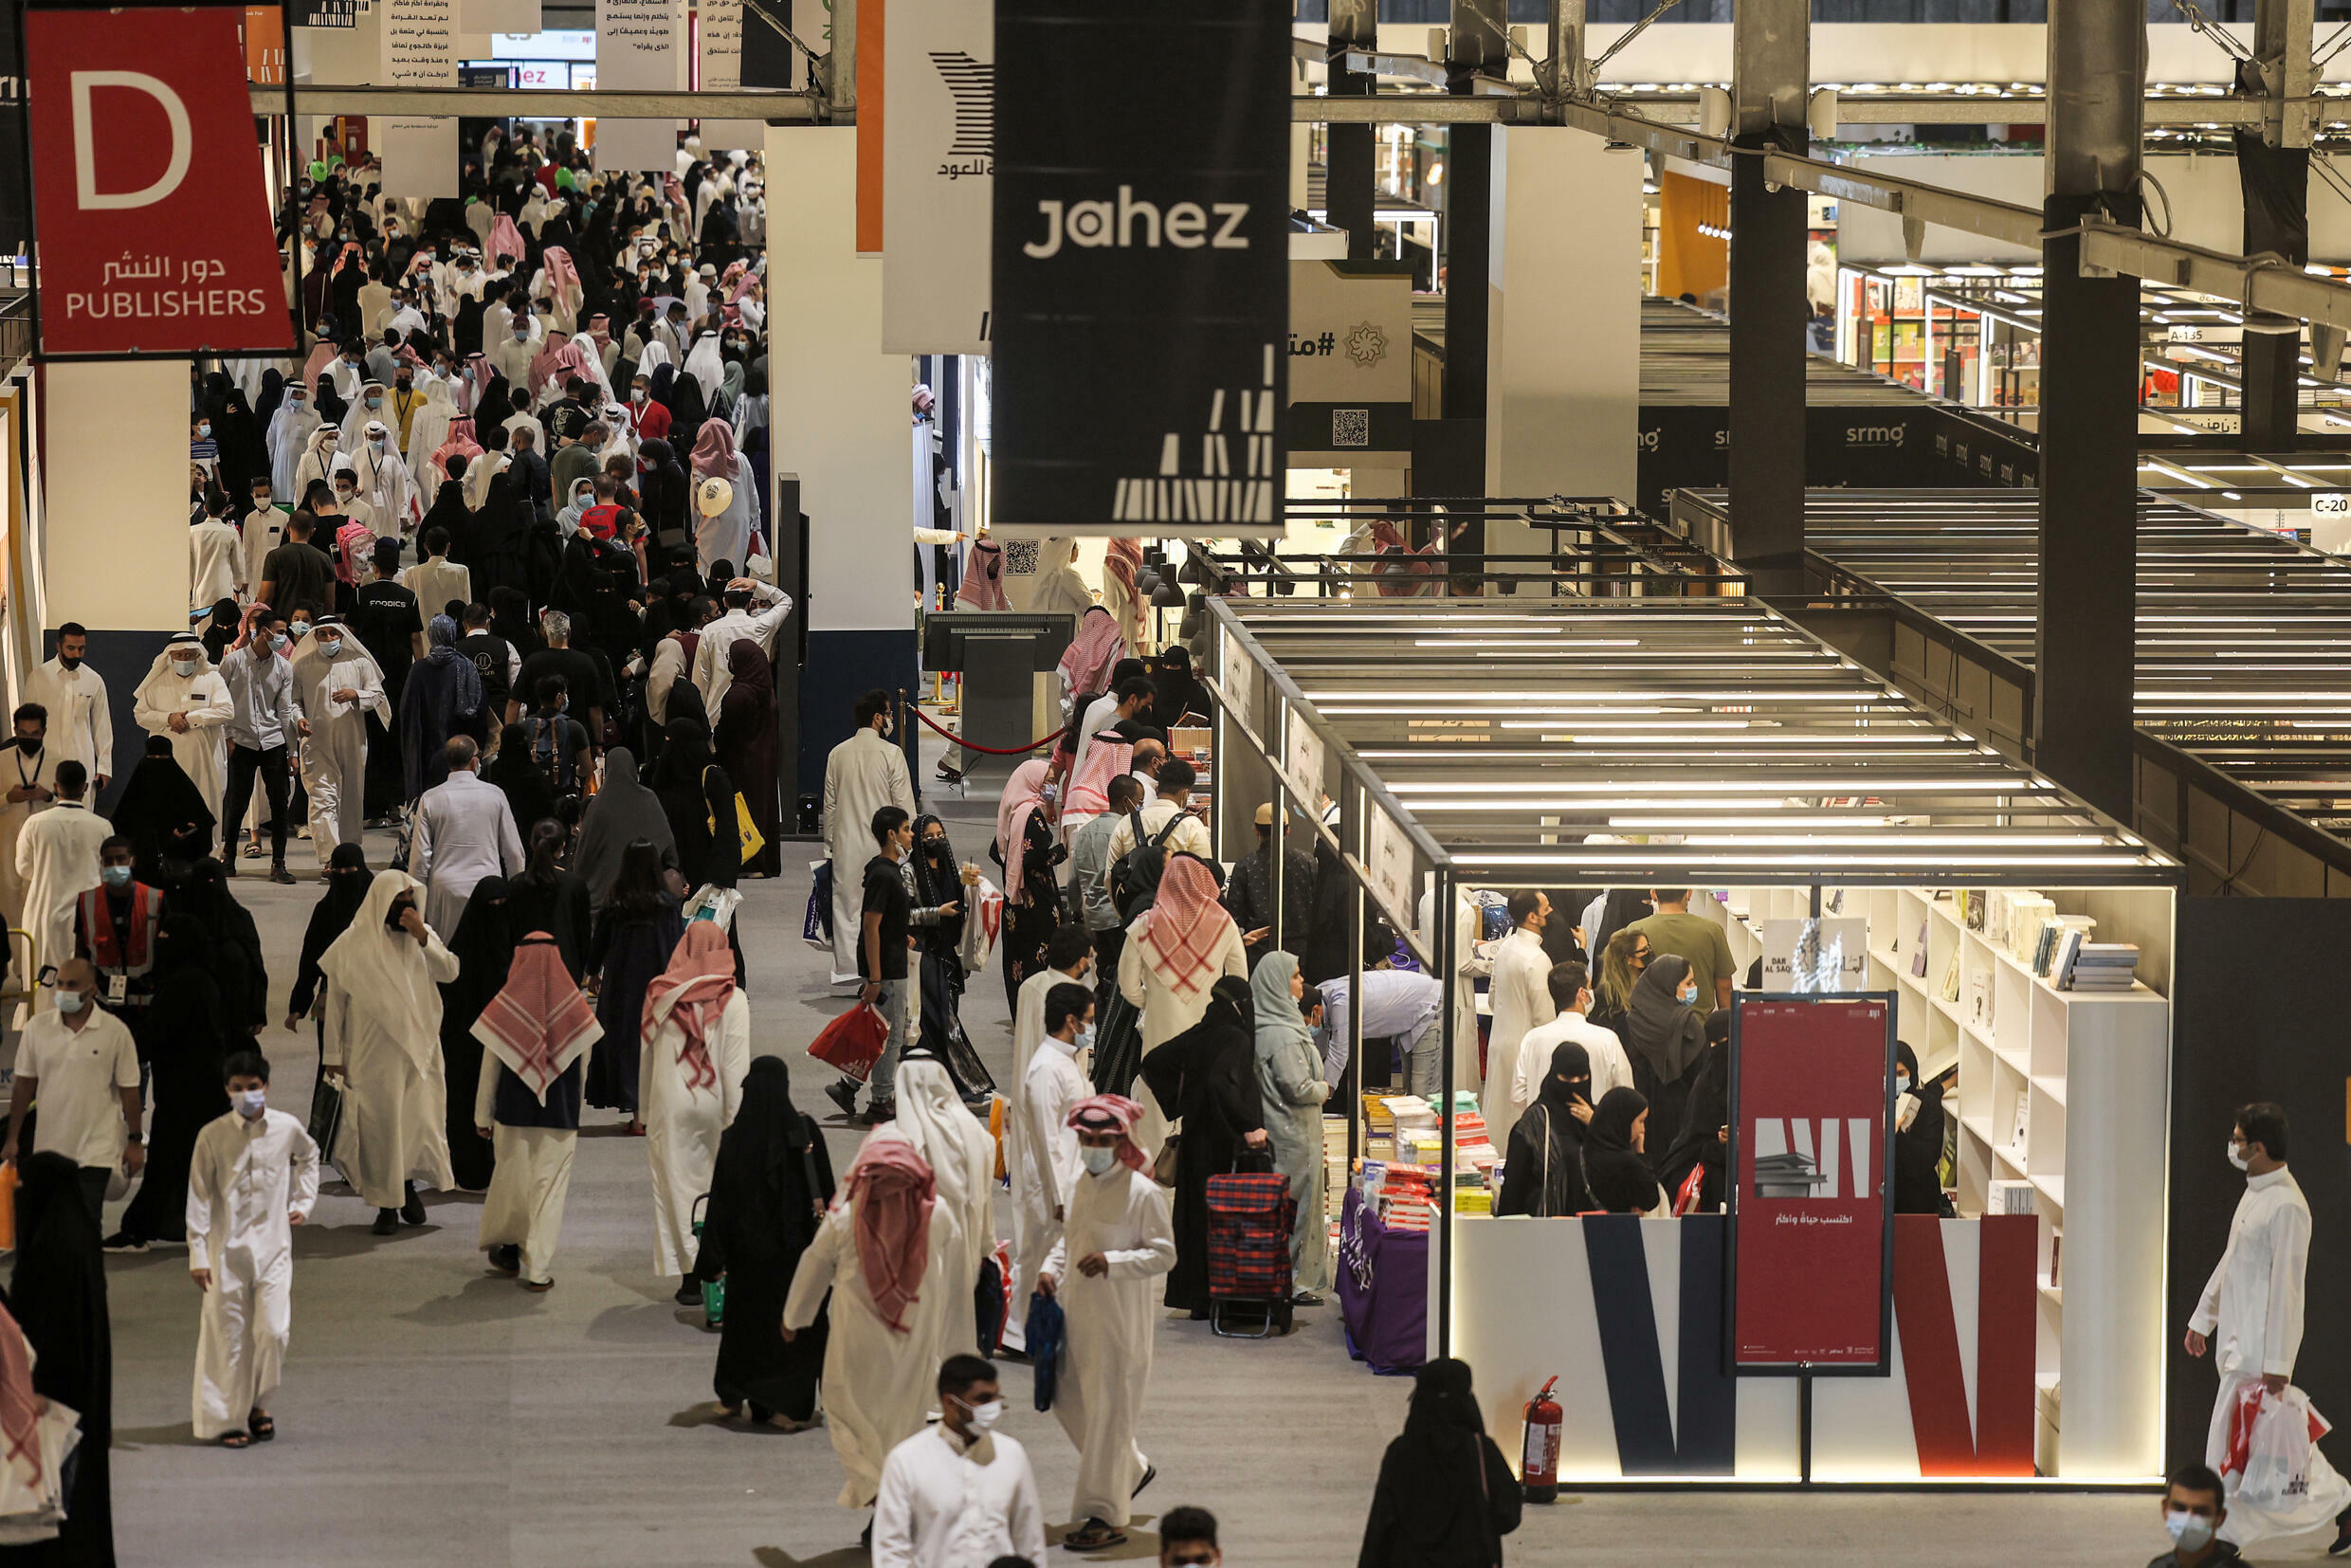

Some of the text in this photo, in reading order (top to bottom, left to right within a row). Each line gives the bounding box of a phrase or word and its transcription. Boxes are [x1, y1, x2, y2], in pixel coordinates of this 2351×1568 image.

[70, 69, 193, 211] D
[937, 158, 984, 180] للعود
[1023, 185, 1250, 260] jahez
[102, 250, 226, 286] دور النشر
[66, 288, 266, 319] PUBLISHERS
[2315, 499, 2348, 513] C-20
[369, 599, 407, 608] FOODICS
[1772, 957, 1786, 966] DAR
[1819, 1213, 1852, 1226] اكتسب
